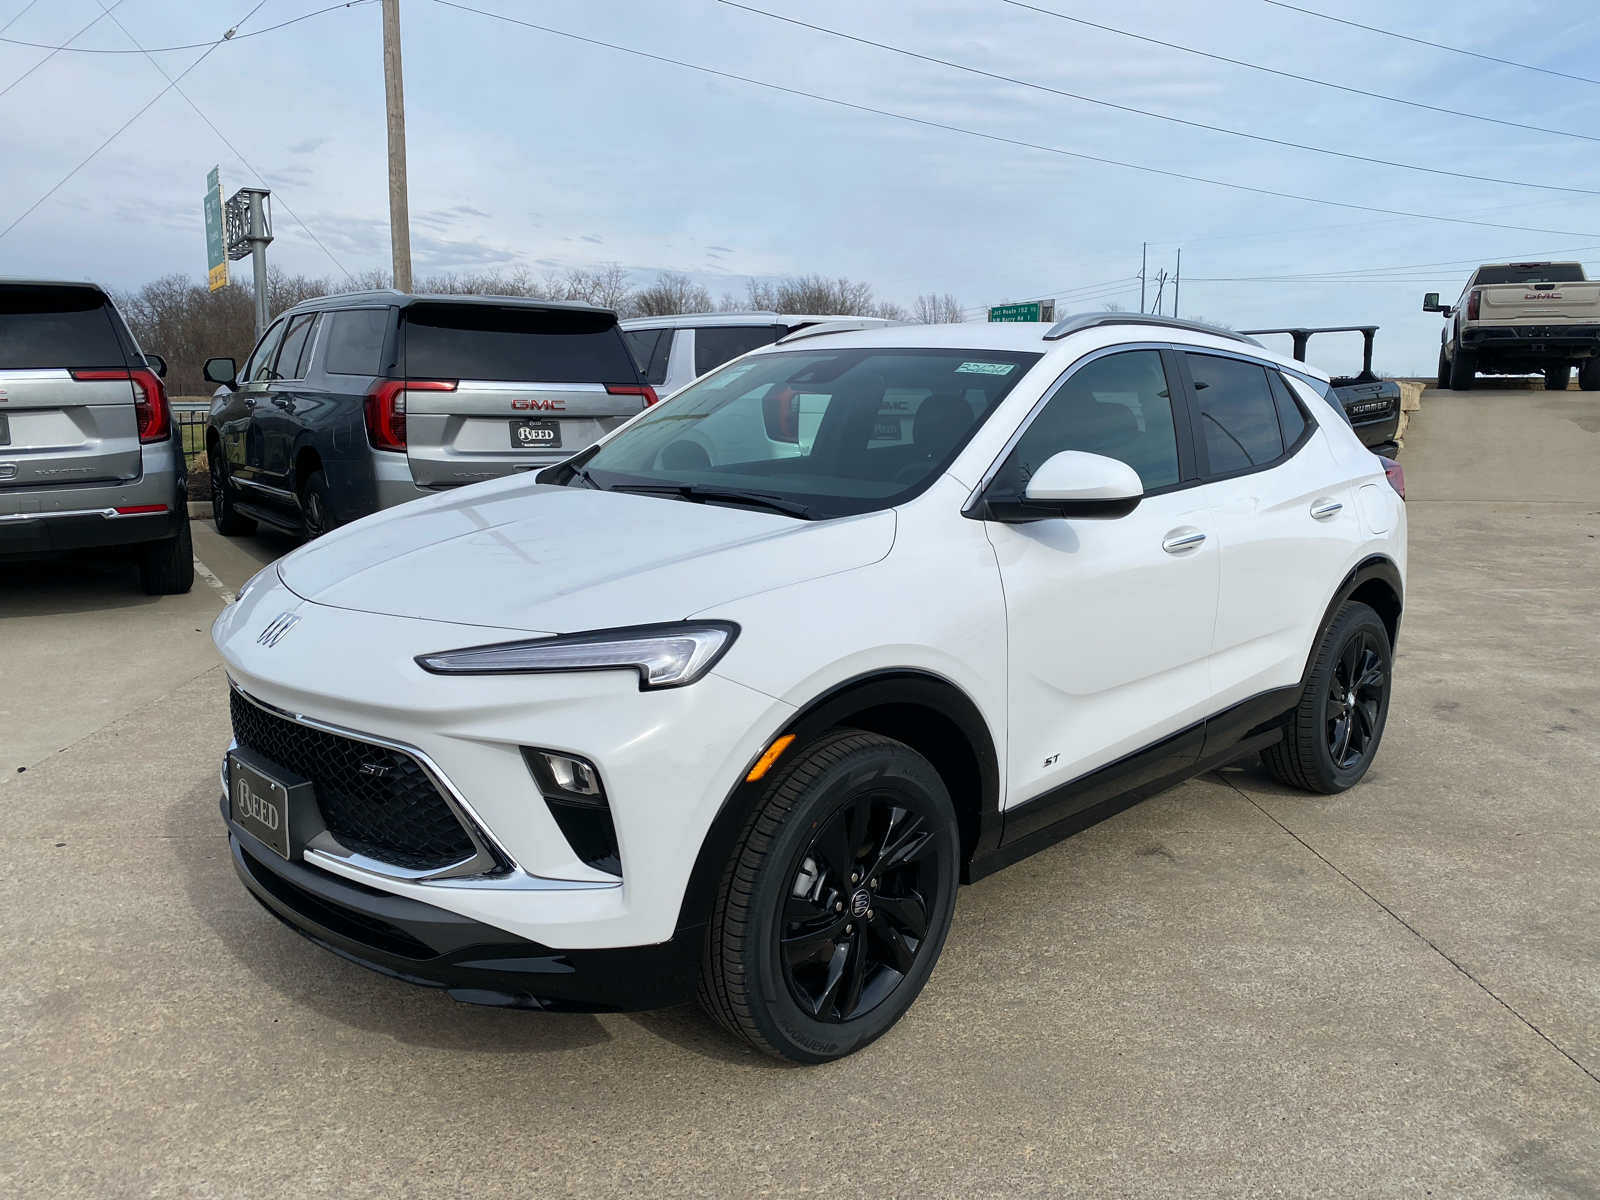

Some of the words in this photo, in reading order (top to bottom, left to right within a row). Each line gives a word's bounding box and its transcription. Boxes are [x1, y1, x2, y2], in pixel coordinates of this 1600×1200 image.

[511, 399, 566, 411] GMC
[1353, 401, 1387, 414] HUMMER
[1042, 753, 1061, 769] ST
[358, 763, 393, 777] ST
